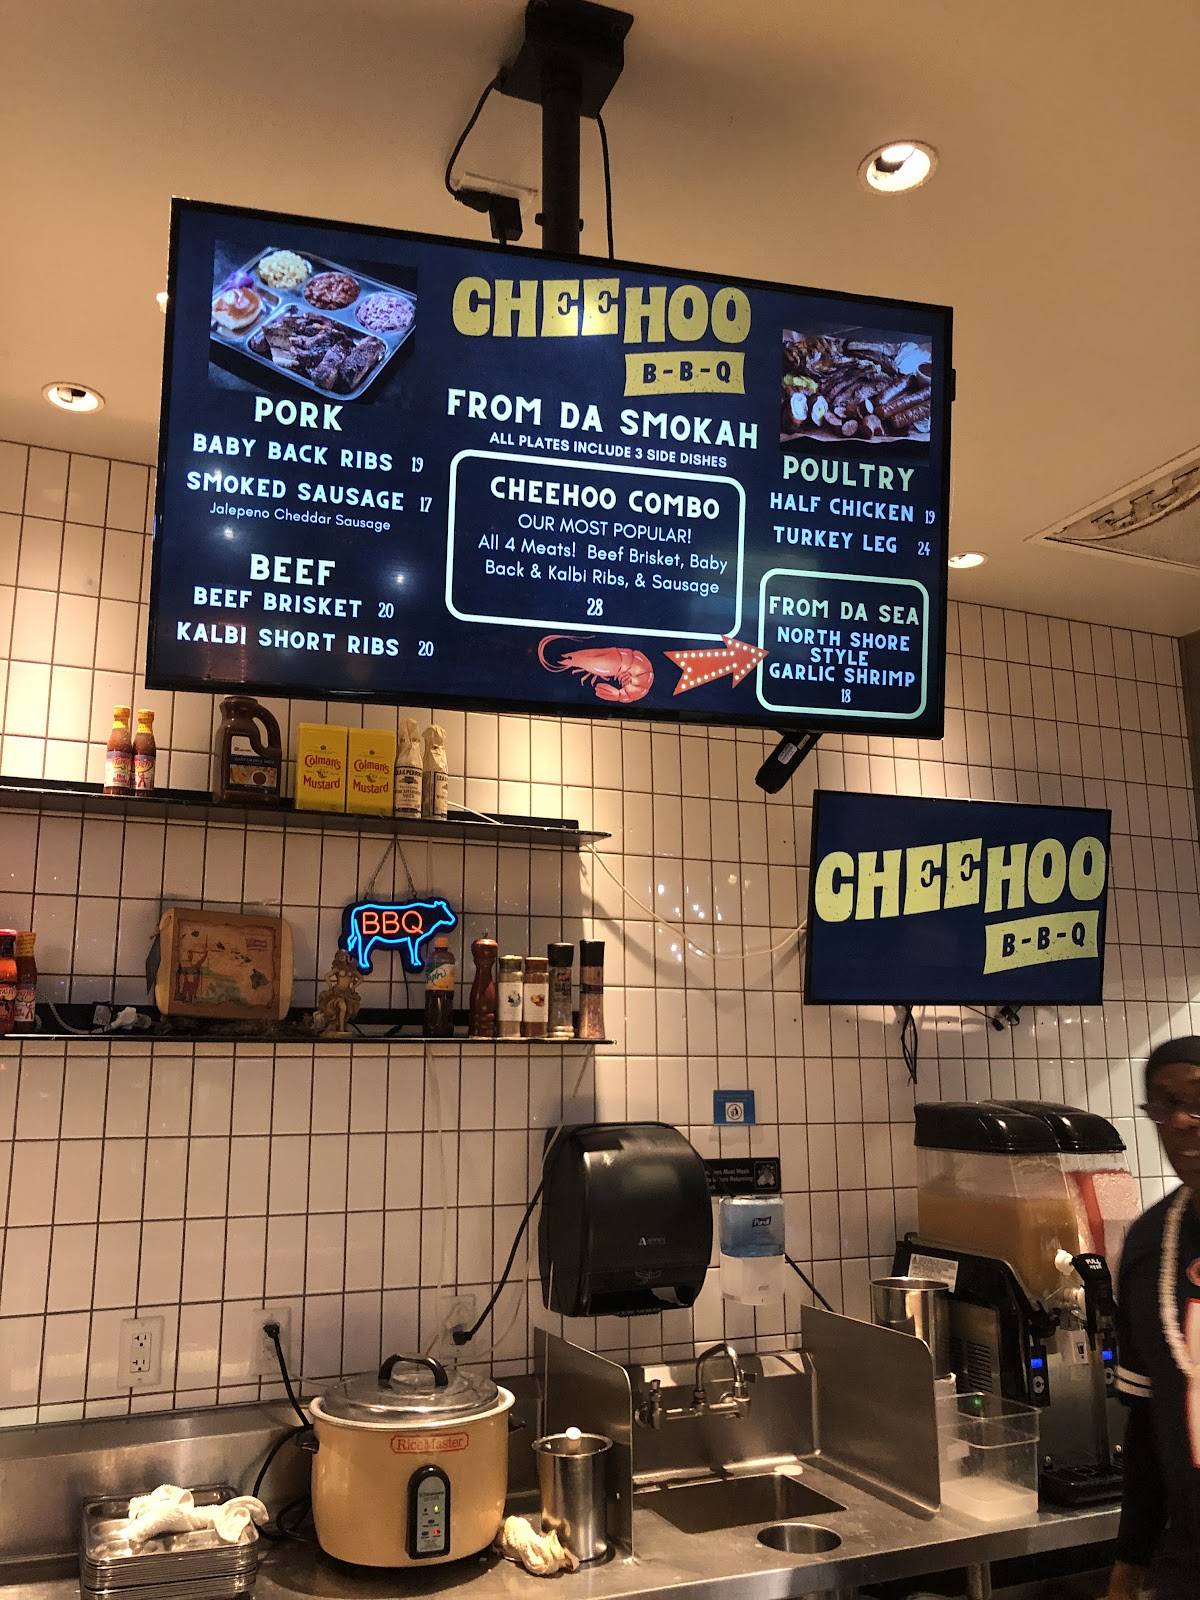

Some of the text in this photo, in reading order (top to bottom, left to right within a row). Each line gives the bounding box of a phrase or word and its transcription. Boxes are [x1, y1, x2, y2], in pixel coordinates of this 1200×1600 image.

[452, 276, 751, 344] CHEEHOO
[643, 361, 731, 384] B-B-Q
[254, 395, 343, 432] PORK
[448, 389, 757, 449] FROM DA SMOKAH
[193, 433, 423, 472] BABY BACK RIBS 19
[490, 432, 727, 468] ALL PLATES INCLUDE 3 SIDE DISHES
[783, 455, 914, 491] POULTRY
[187, 471, 432, 512] SMOKED SAUSAGE 17
[491, 477, 719, 519] CHEEHOO COMBO
[210, 502, 390, 532] Jalepeno Cheddar Sausage
[771, 492, 935, 524] HALF CHICKEN 19
[518, 514, 691, 543] OUR MOST POPULAR!
[774, 526, 930, 555] TURKEY LEG 24
[250, 554, 335, 585] BEEF
[479, 534, 727, 574] All 4 Meats! Beef Brisket, Baby
[486, 559, 719, 597] Back & Kalbi Ribs, & Sausage
[194, 586, 394, 618] BEEF BRISKET 20
[587, 598, 603, 616] 28
[770, 596, 919, 625] FROM DA SEA
[177, 622, 434, 656] KALBI SHORT RIBS 20
[778, 627, 909, 651] NORTH SHORE
[811, 647, 868, 666] STYLE
[769, 663, 915, 686] GARLIC SHRIMP
[842, 689, 851, 703] 18
[303, 774, 341, 790] Mustard
[352, 778, 389, 794] Mustard
[815, 836, 1106, 922] CHEEHOO
[362, 911, 423, 934] BBQ
[1002, 922, 1086, 957] B-B-Q
